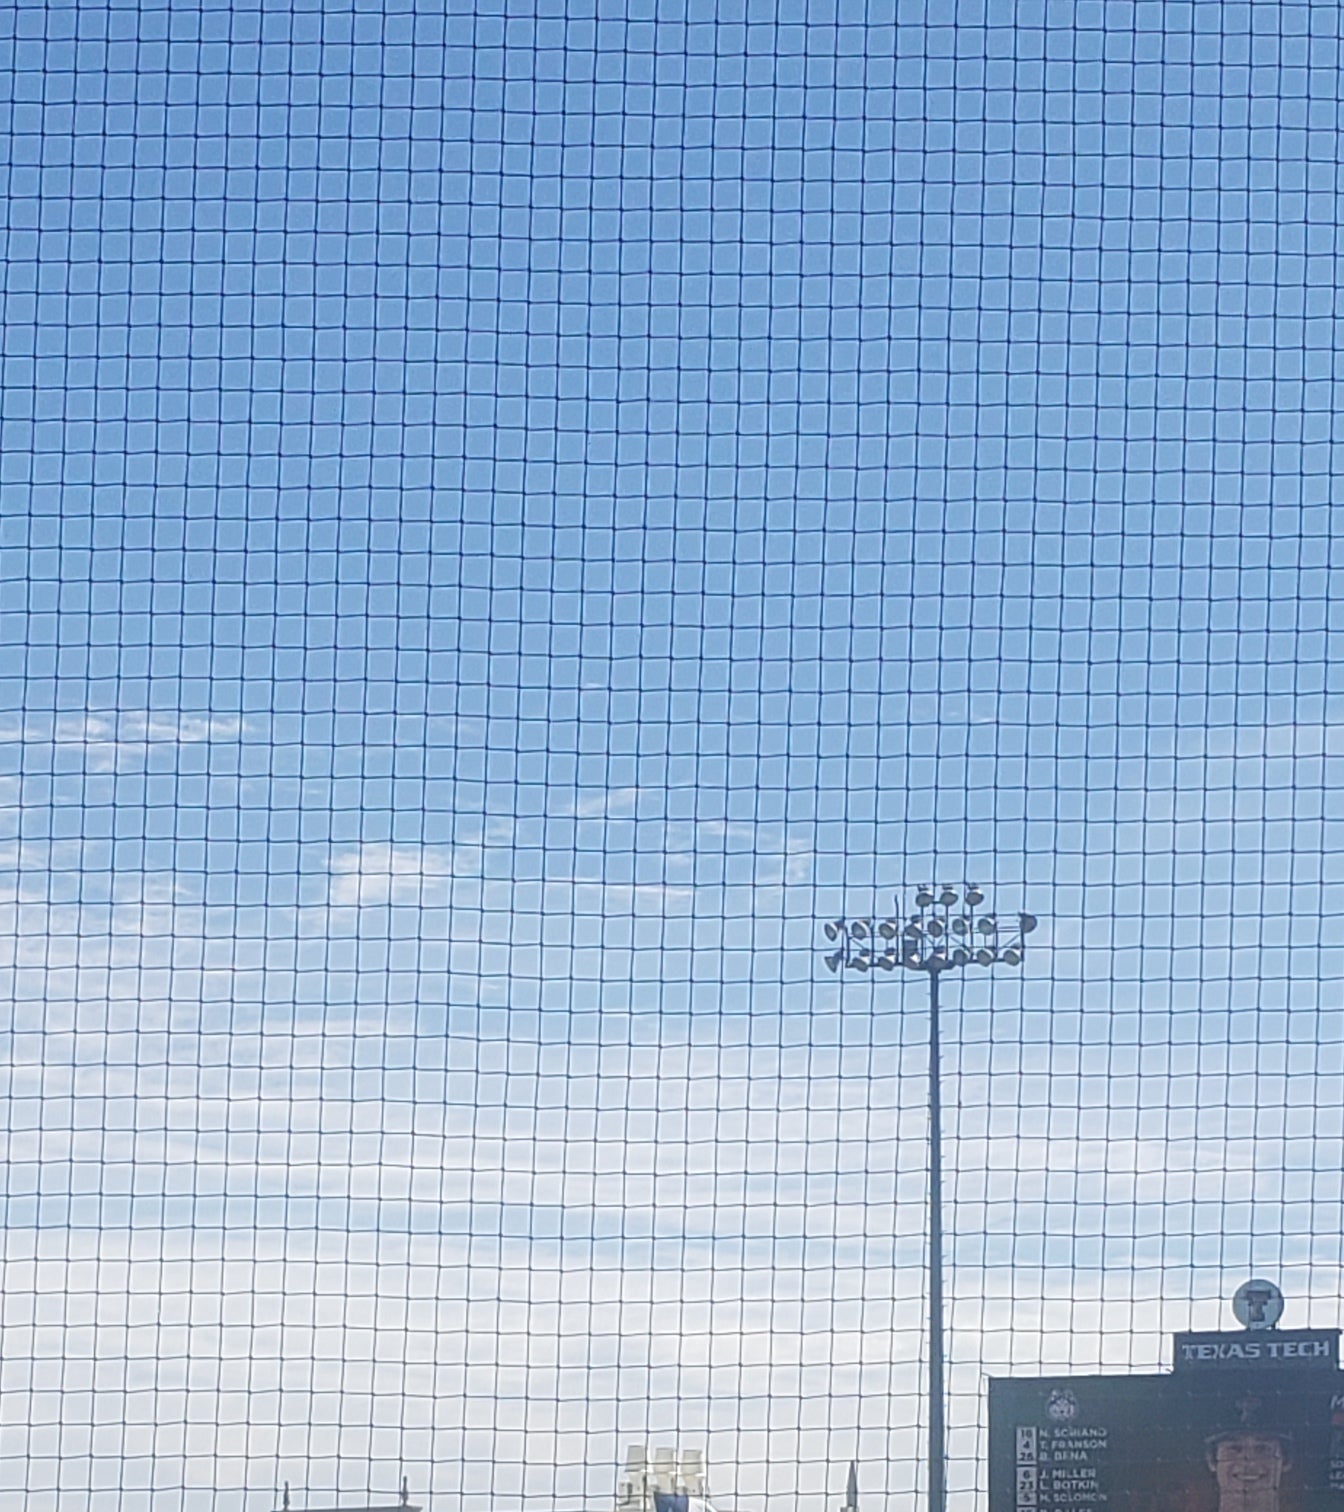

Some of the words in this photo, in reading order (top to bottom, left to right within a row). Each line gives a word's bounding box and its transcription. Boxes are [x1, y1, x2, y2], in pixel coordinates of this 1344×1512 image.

[1182, 1342, 1261, 1360] TEXAS
[1267, 1340, 1330, 1358] TECH
[1052, 1468, 1096, 1479] MILLER
